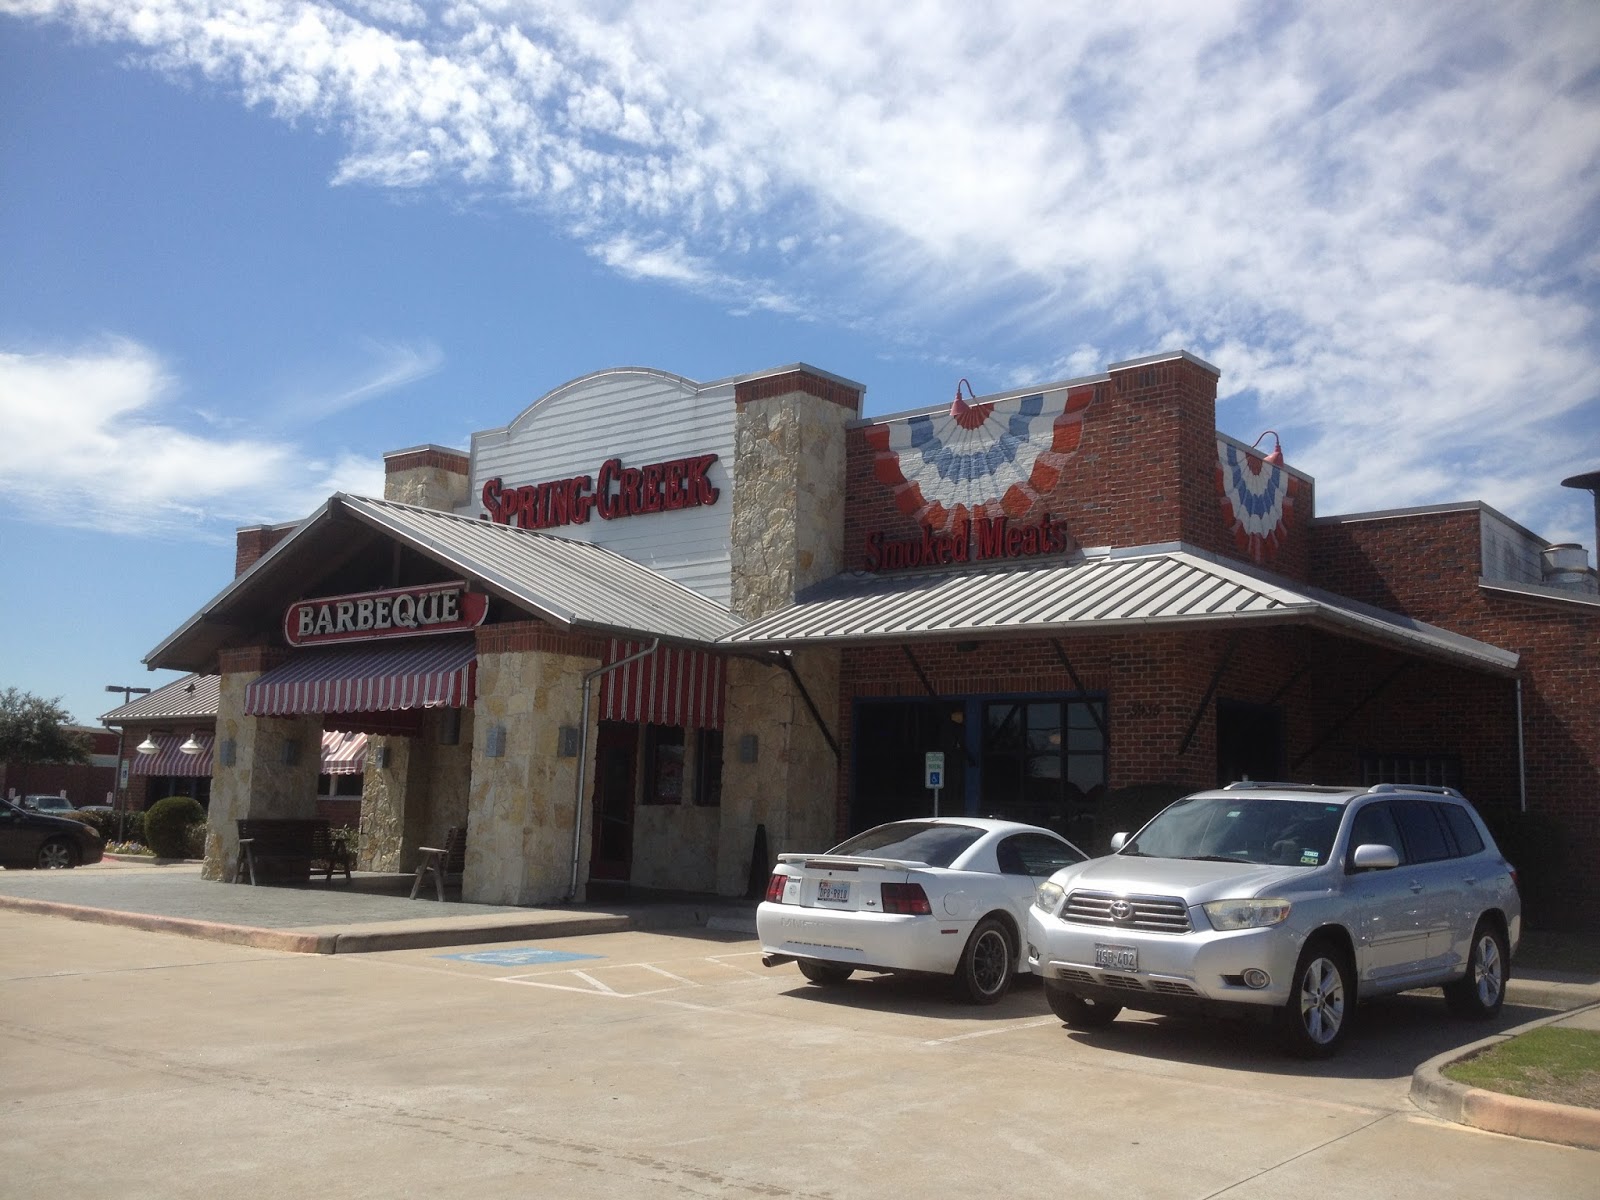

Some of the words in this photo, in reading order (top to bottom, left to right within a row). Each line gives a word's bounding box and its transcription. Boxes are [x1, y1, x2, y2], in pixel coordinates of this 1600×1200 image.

[597, 454, 720, 520] CREEK
[865, 519, 971, 572] Smoked
[976, 513, 1069, 561] Meats
[298, 590, 459, 636] BARBEQUE
